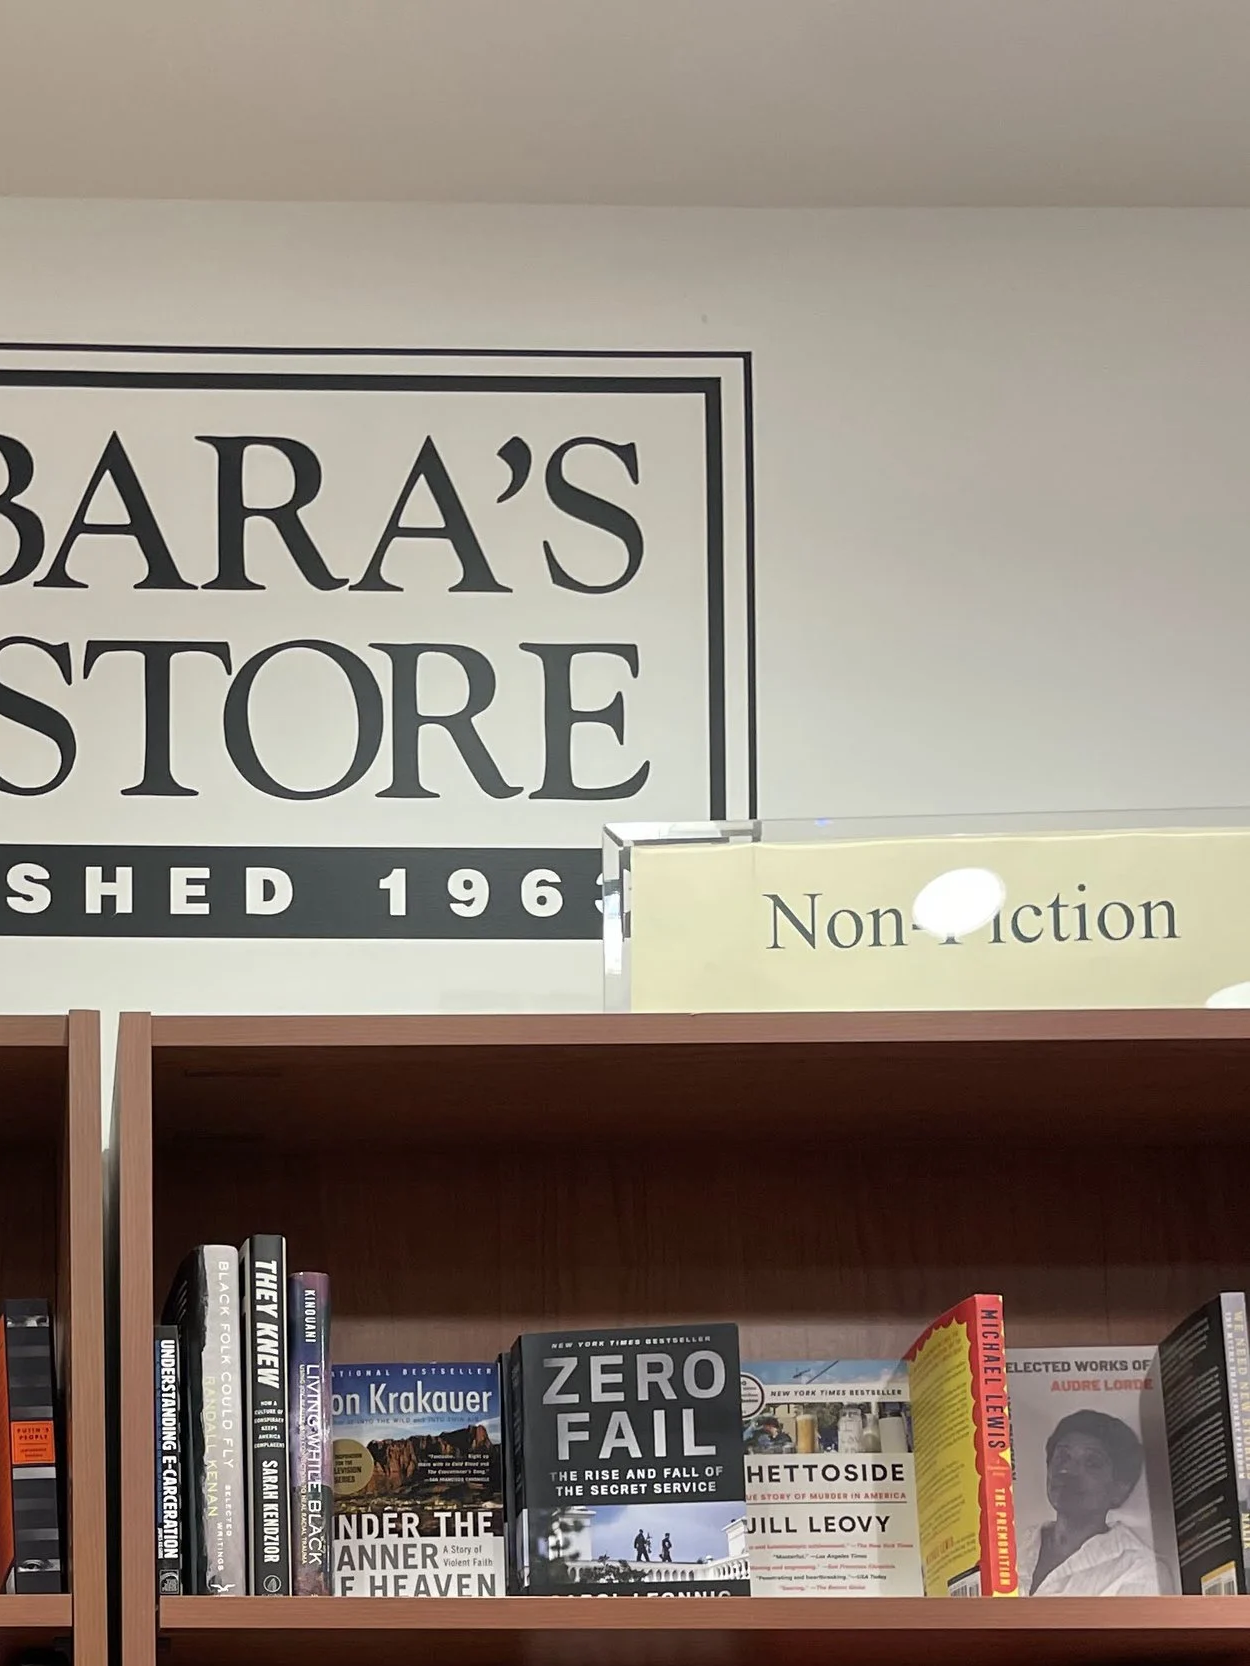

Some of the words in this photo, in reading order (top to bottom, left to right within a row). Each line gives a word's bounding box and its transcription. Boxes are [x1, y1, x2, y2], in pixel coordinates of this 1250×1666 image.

[378, 867, 603, 918] 196
[255, 1260, 279, 1320] THEY
[256, 1327, 279, 1388] KNEW
[980, 1309, 1001, 1385] MICHAEL
[369, 1381, 492, 1414] Krakauer
[542, 1350, 728, 1405] ZERO
[1051, 1380, 1100, 1392] AUDRE
[1104, 1378, 1153, 1391] LORDE
[556, 1408, 717, 1460] FAIL
[985, 1394, 1006, 1449] LEWIS
[262, 1460, 278, 1500] SARAH
[550, 1471, 578, 1481] THE
[584, 1470, 619, 1480] RISE
[626, 1469, 656, 1479] AND
[664, 1467, 699, 1478] FALL
[705, 1466, 724, 1476] OF
[556, 1486, 583, 1496] THE
[591, 1484, 647, 1495] SECRET
[653, 1482, 716, 1493] SERVICE
[262, 1502, 280, 1563] KENDZIOR
